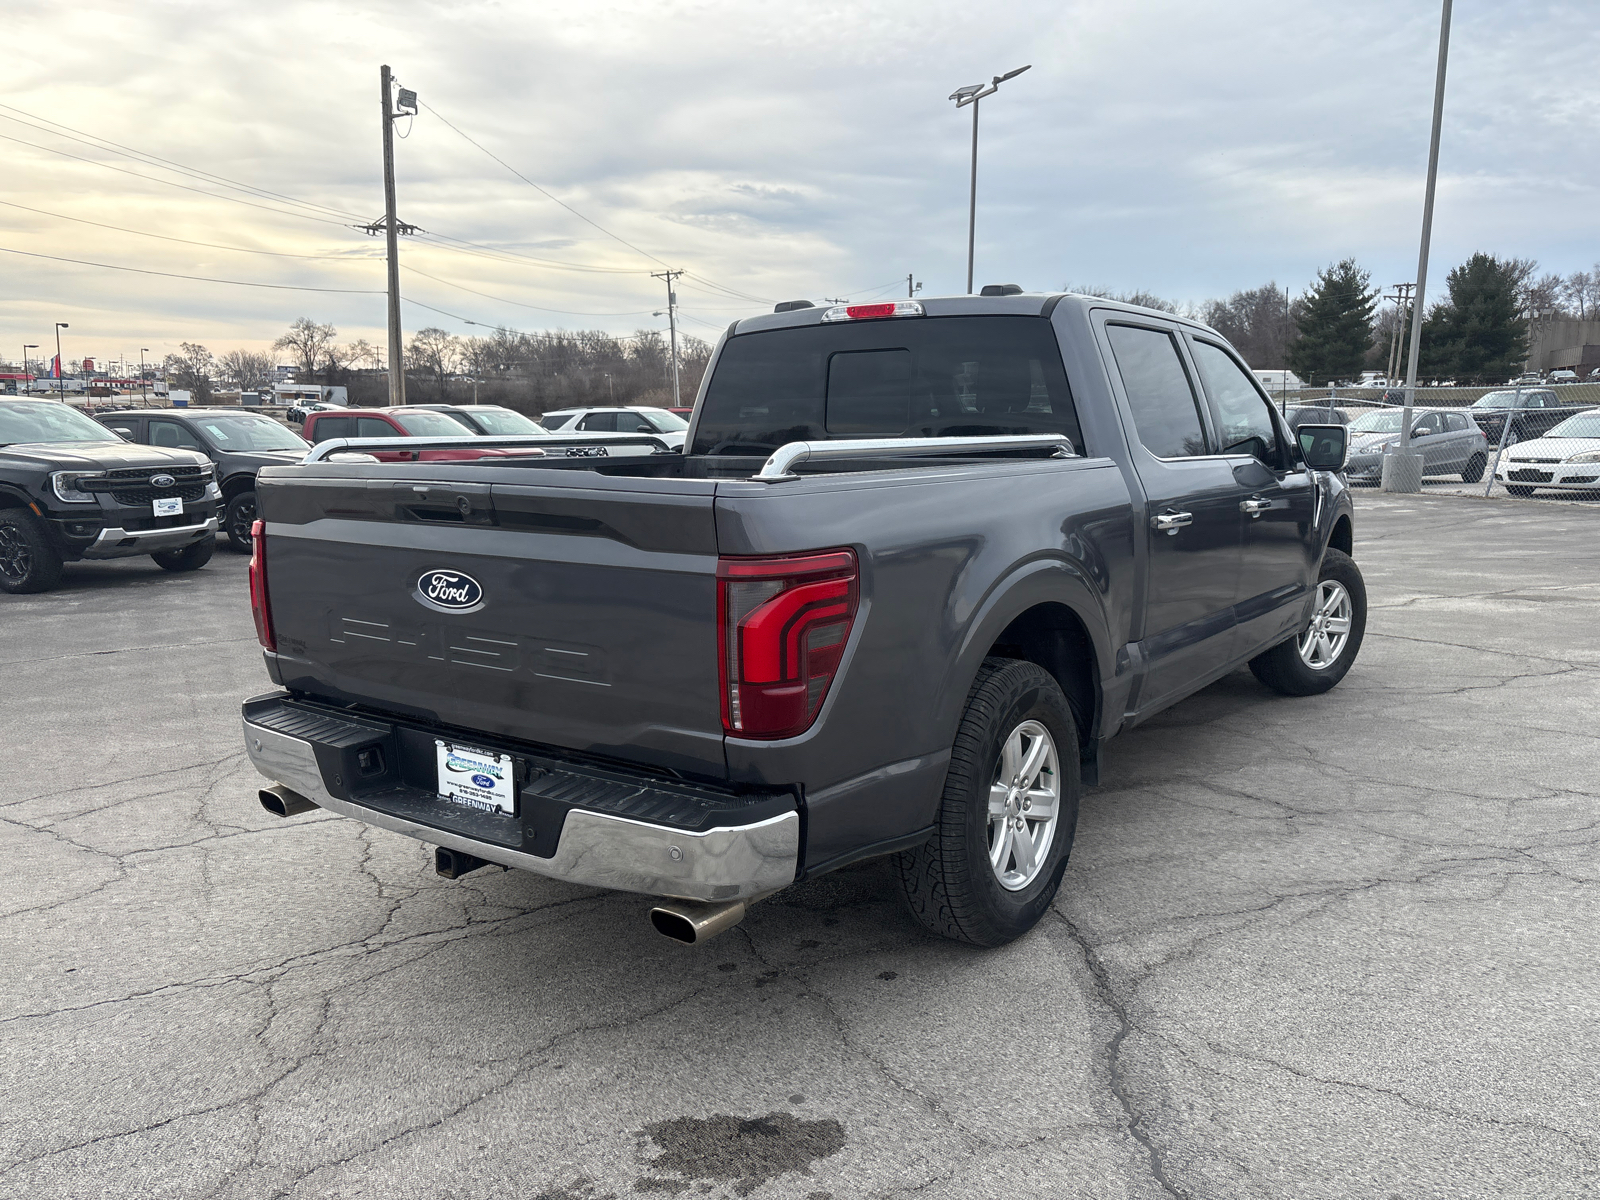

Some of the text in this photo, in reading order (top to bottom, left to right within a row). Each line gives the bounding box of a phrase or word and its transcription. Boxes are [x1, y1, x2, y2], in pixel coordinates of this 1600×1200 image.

[428, 574, 469, 602] Ford
[475, 775, 491, 787] Ford
[452, 795, 496, 813] GREENWAY
